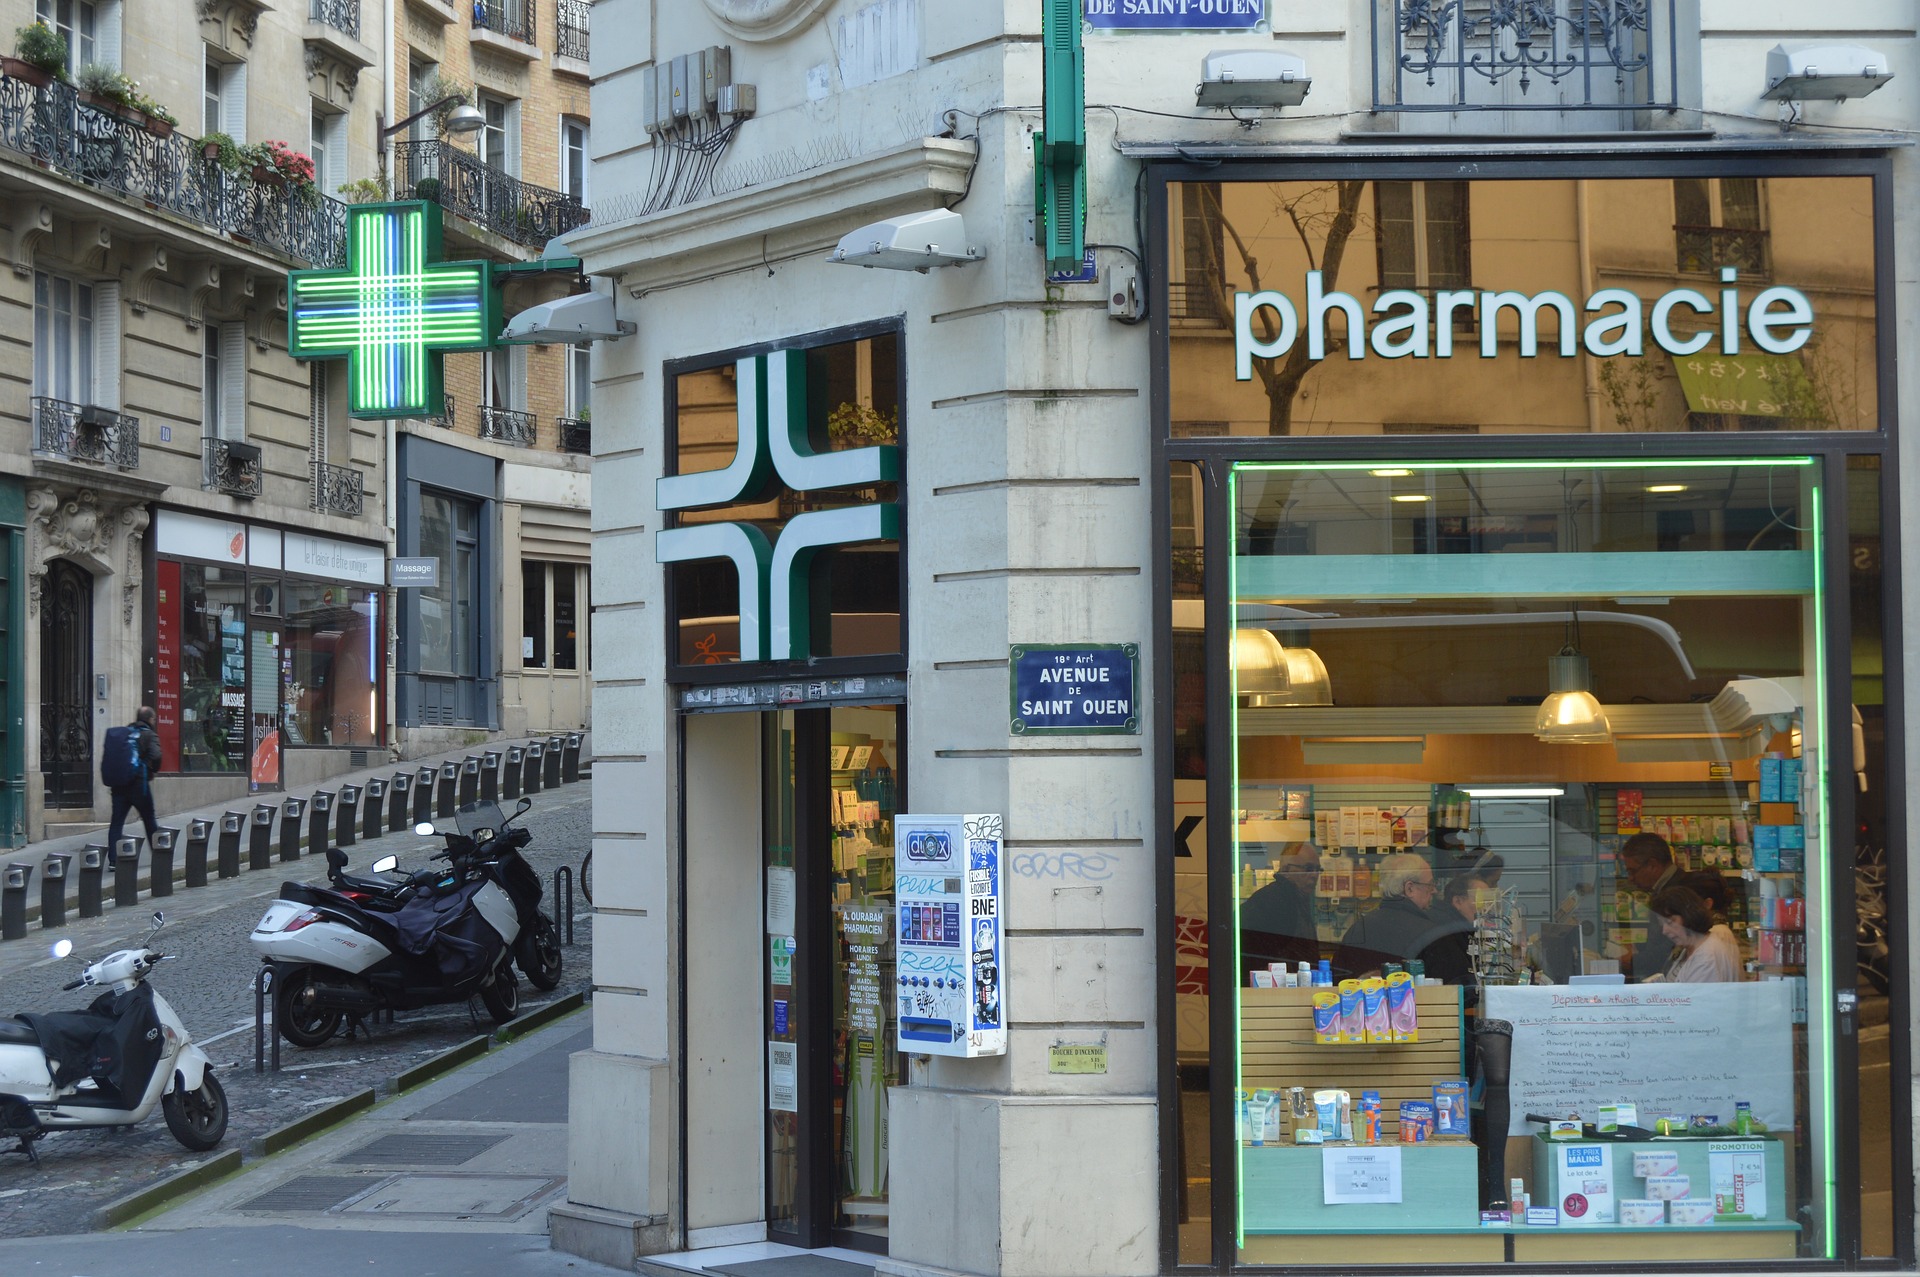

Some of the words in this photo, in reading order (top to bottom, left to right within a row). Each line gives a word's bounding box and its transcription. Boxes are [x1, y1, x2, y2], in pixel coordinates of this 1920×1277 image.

[1087, 0, 1116, 14] DE
[1123, 0, 1260, 14] SAINT-OUEN
[1234, 267, 1815, 381] pharmacie
[395, 564, 432, 574] Massage
[1040, 668, 1110, 683] AVENUE
[1068, 687, 1081, 695] DE
[222, 692, 245, 707] MASSAGE
[1021, 700, 1073, 716] SAINT
[1083, 699, 1128, 715] OUEN
[972, 898, 995, 916] BNE
[843, 911, 850, 921] A.
[851, 912, 883, 922] OURABAH
[843, 923, 883, 935] PHARMACIEN
[850, 945, 879, 954] HORAIRES
[1052, 1048, 1074, 1056] BOUCHE
[1568, 1149, 1582, 1157] LES
[1583, 1148, 1600, 1156] PRIX
[1710, 1143, 1763, 1151] PROMOTION
[1568, 1156, 1601, 1164] MALINS
[1735, 1175, 1744, 1213] OFFERT
